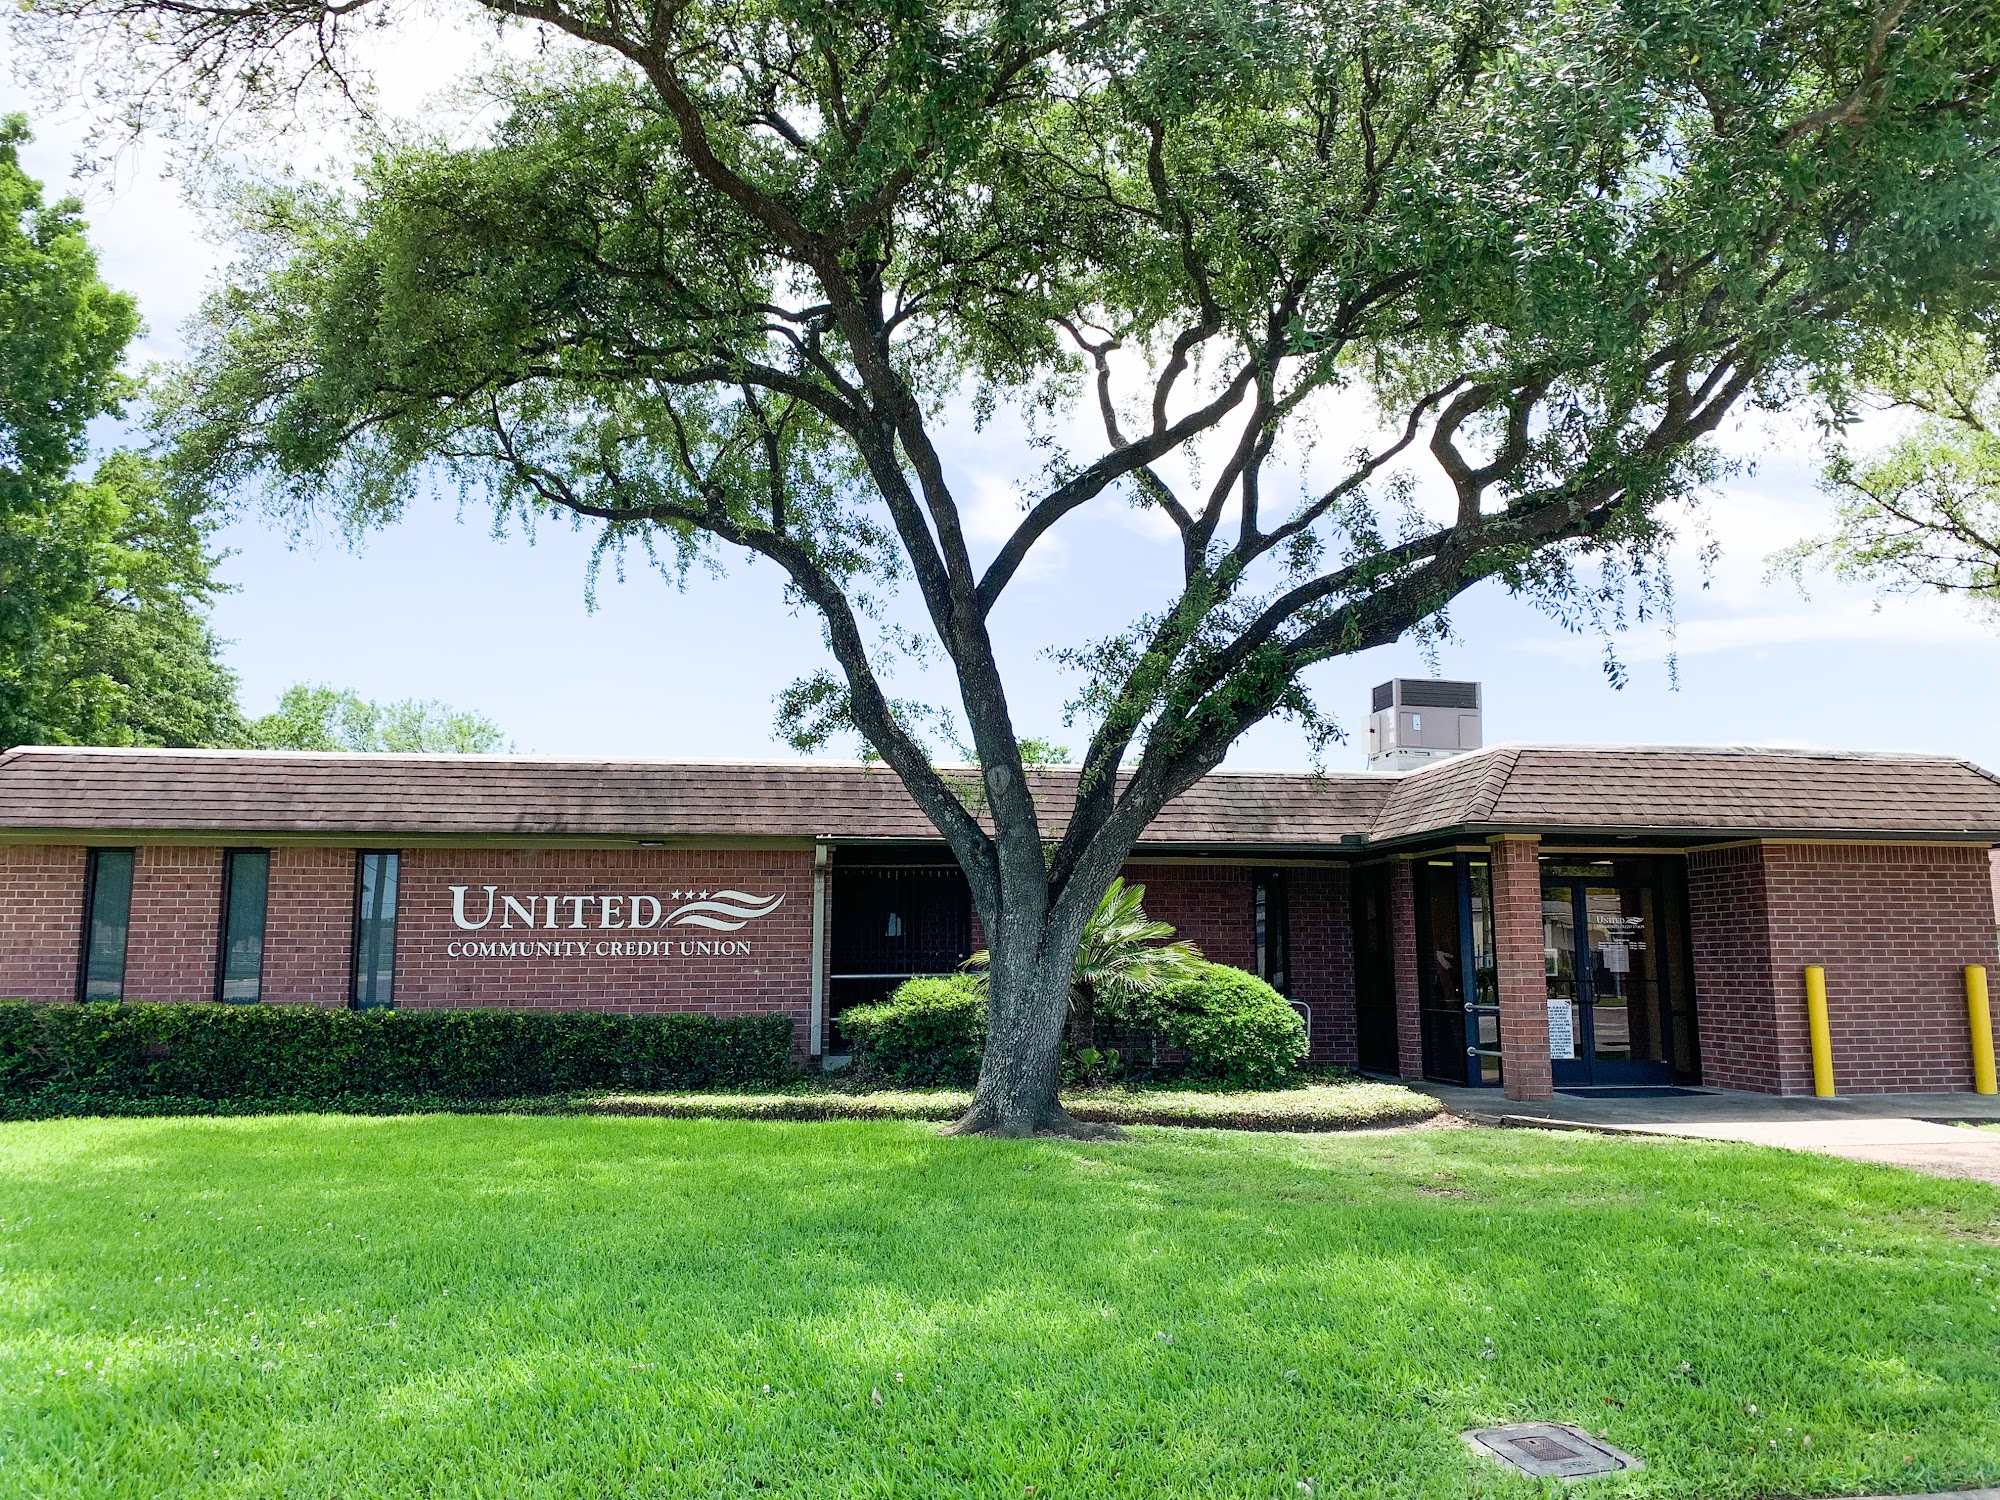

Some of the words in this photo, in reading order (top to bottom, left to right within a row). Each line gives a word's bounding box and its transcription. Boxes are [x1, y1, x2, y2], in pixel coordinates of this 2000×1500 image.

[448, 885, 663, 930] UNITED
[1596, 915, 1625, 924] UNITED
[447, 940, 591, 957] COMMUNITY
[595, 940, 674, 957] CREDIT
[680, 940, 752, 957] UNION
